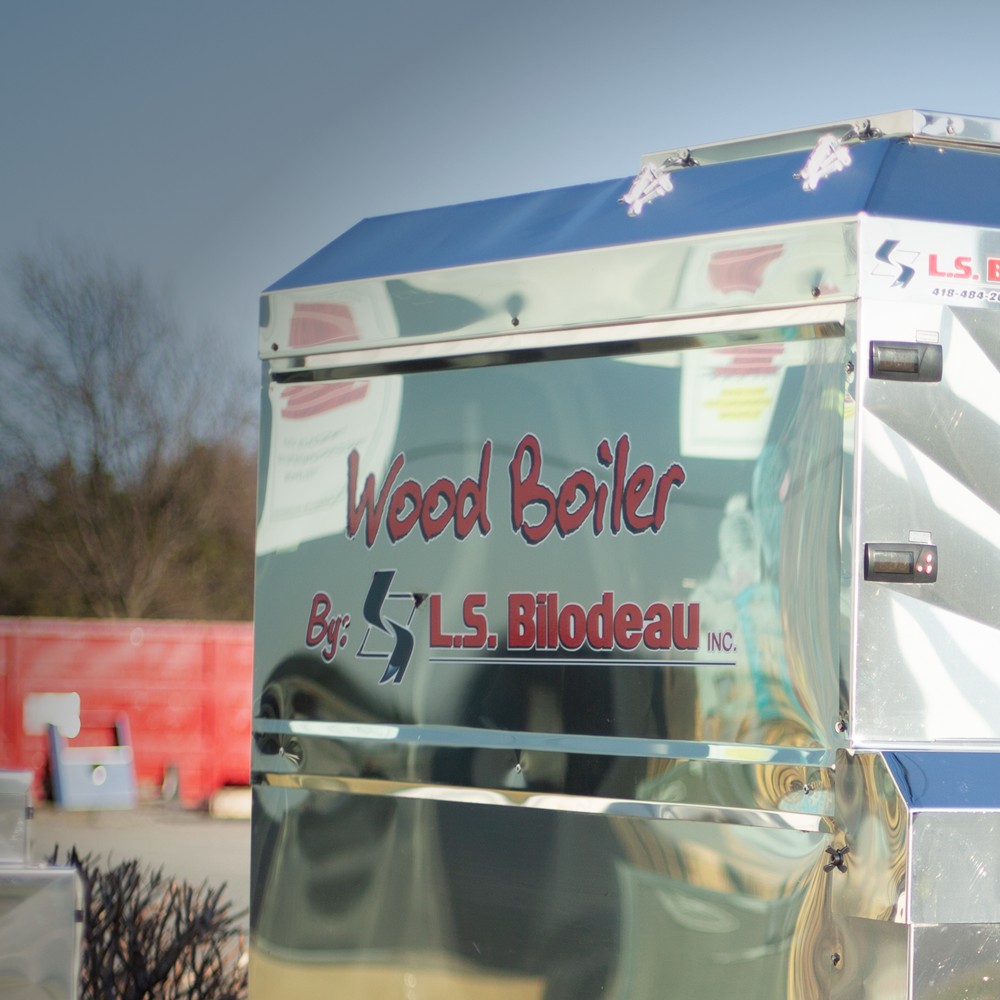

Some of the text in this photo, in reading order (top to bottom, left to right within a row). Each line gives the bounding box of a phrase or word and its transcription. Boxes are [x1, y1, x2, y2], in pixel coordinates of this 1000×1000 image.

[928, 254, 979, 280] L.S.
[346, 438, 492, 549] Wood
[509, 433, 686, 545] Boiler
[305, 591, 736, 663] By: L.S. Bilodeau INC.
